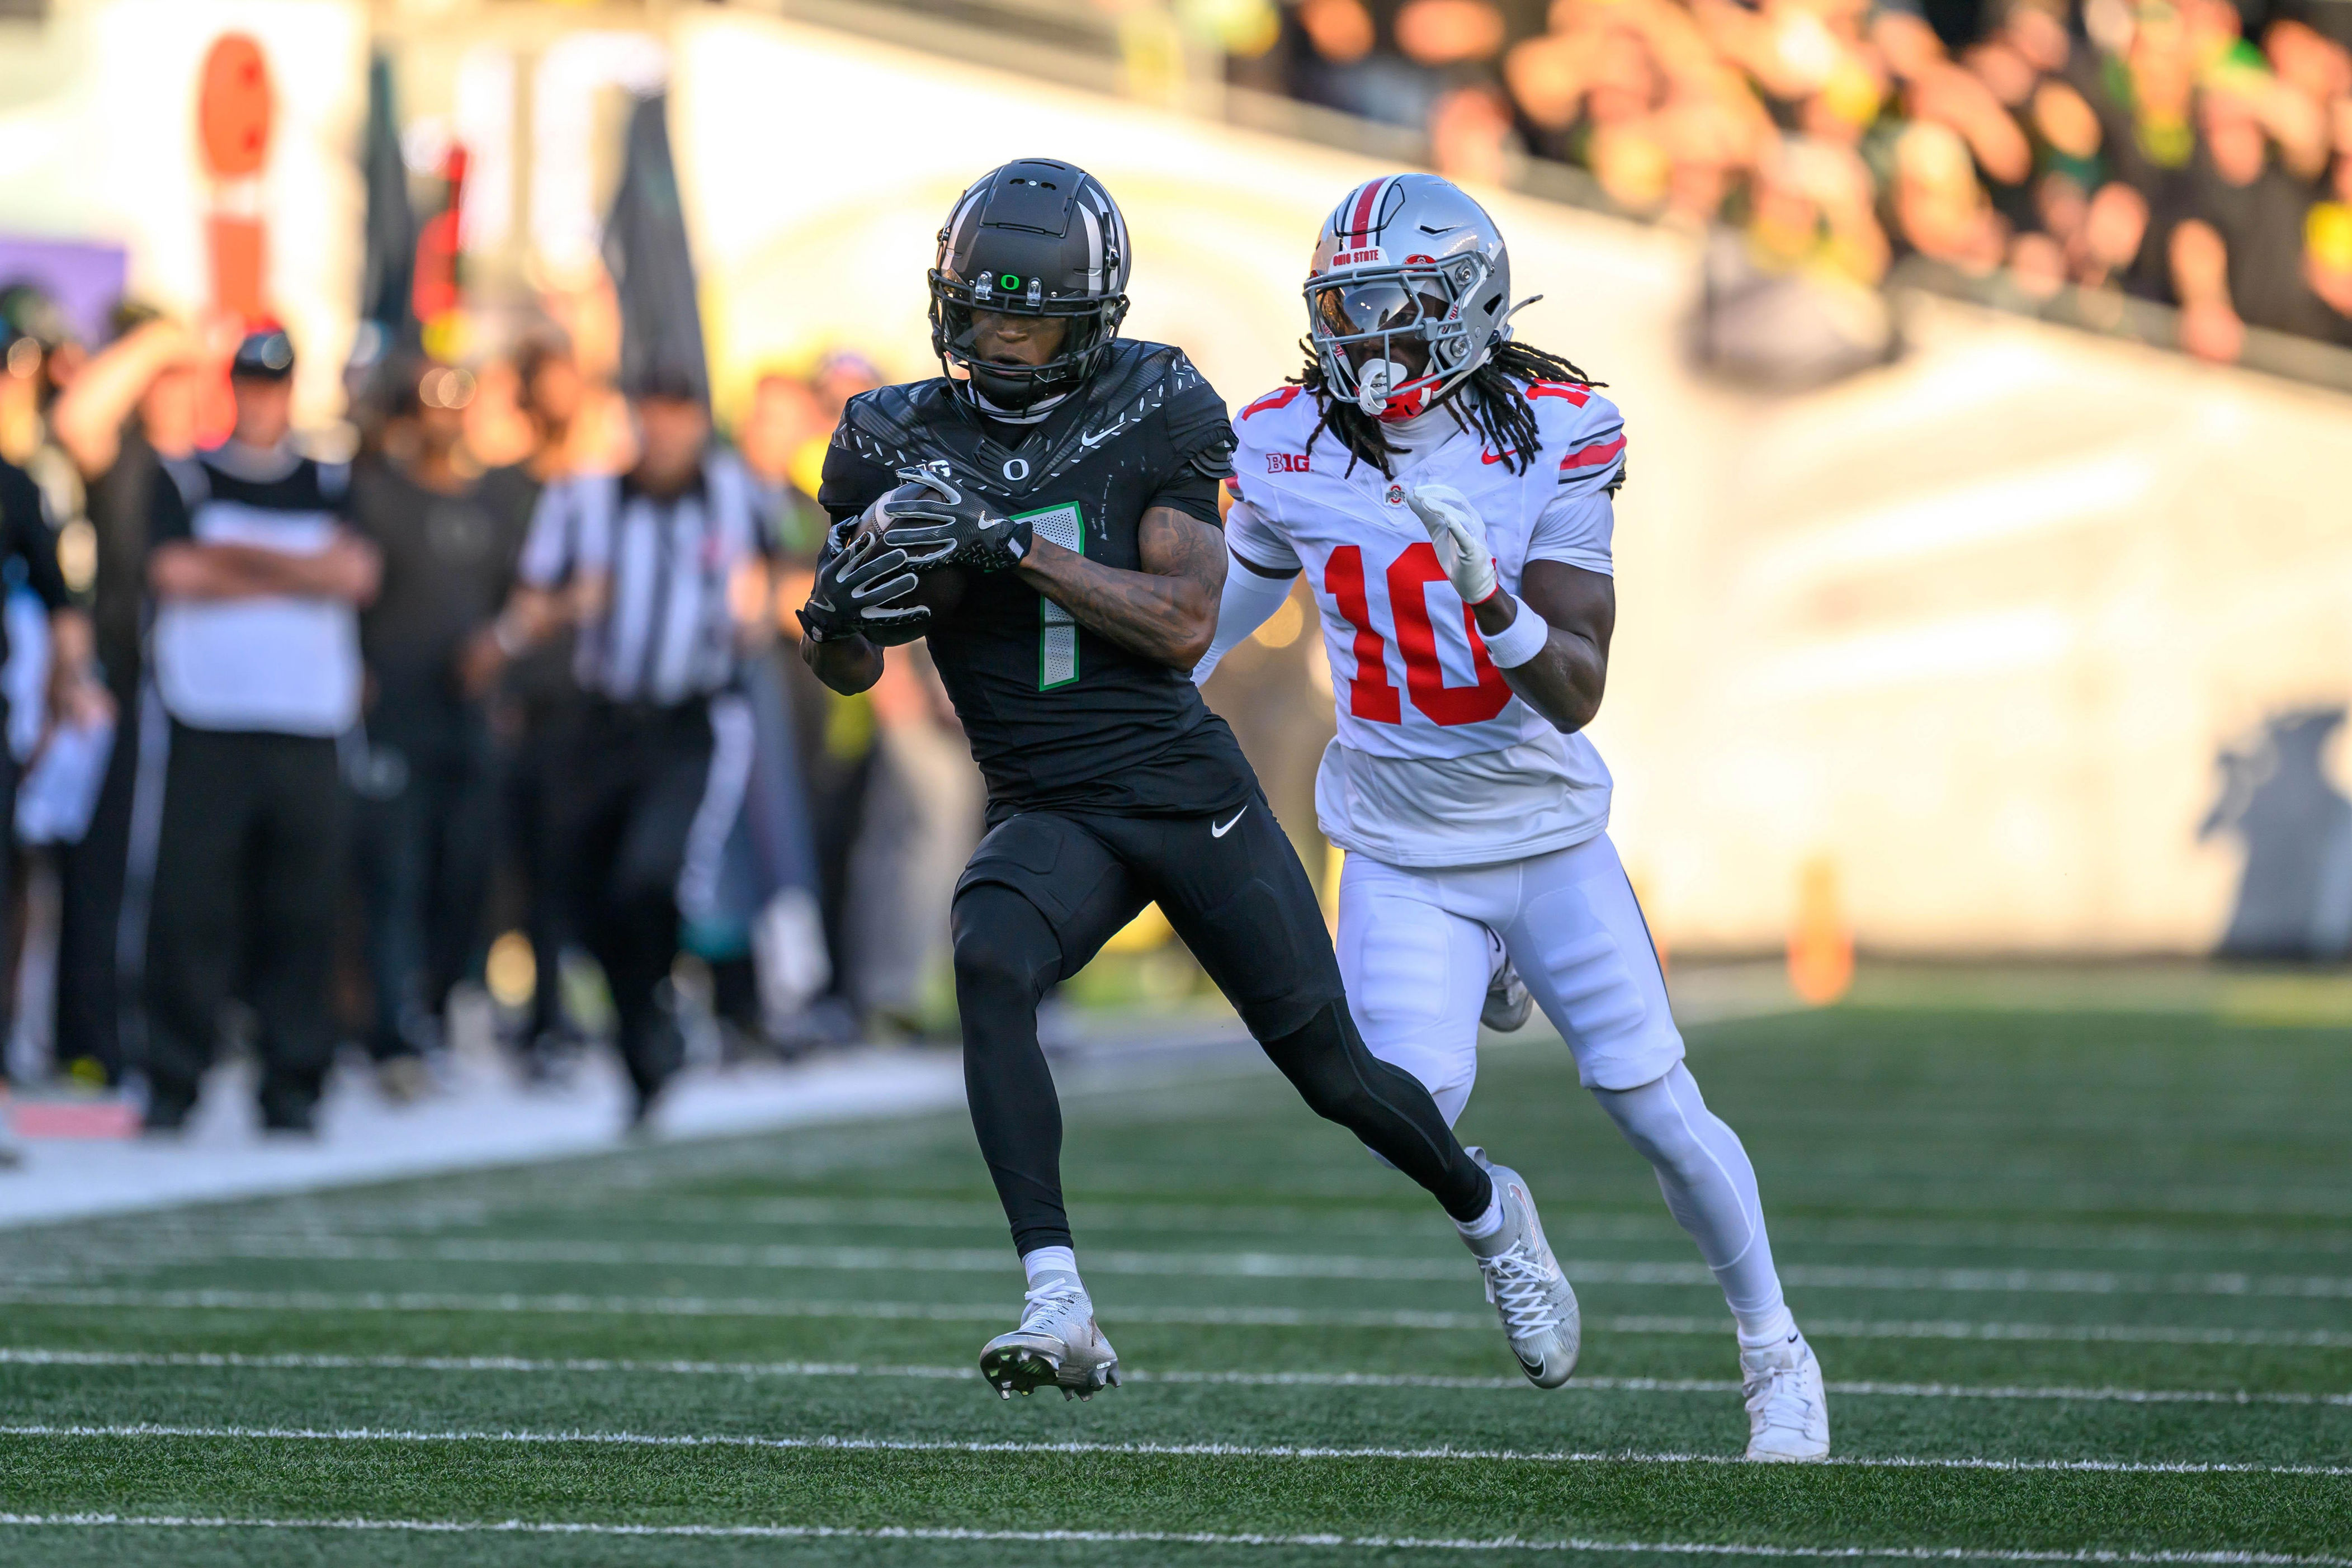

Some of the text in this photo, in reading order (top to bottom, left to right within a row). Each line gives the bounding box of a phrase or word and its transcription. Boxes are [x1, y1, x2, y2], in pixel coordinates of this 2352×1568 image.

[1333, 249, 1379, 266] OHIO STATE
[1001, 275, 1019, 290] O
[1003, 459, 1029, 480] O
[1325, 542, 1513, 727] 10
